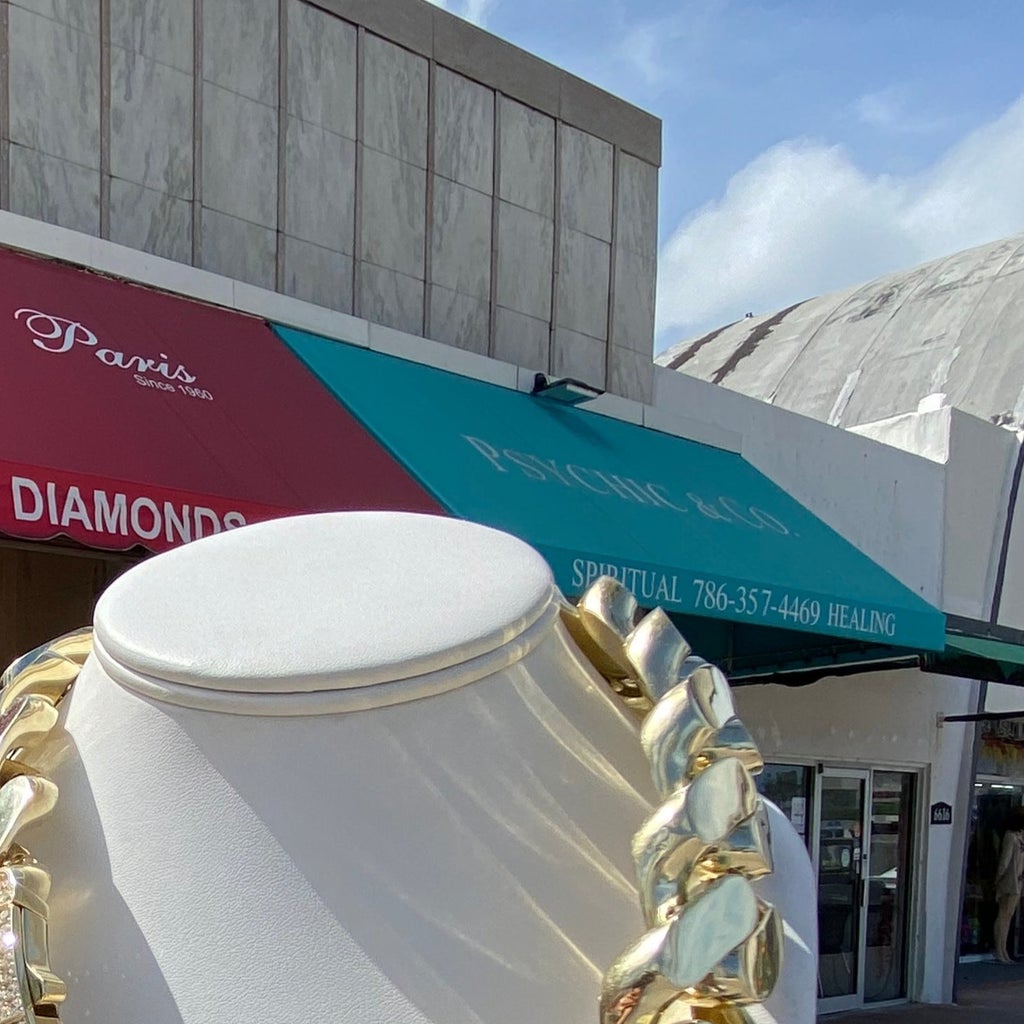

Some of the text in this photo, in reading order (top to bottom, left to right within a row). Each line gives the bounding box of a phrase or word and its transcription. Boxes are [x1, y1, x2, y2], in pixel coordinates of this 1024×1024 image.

[14, 308, 196, 383] Paris
[133, 374, 214, 401] Since 1960
[461, 434, 689, 512] PSYCHIC
[692, 578, 821, 626] 786-357-4469
[827, 602, 896, 637] HEALING
